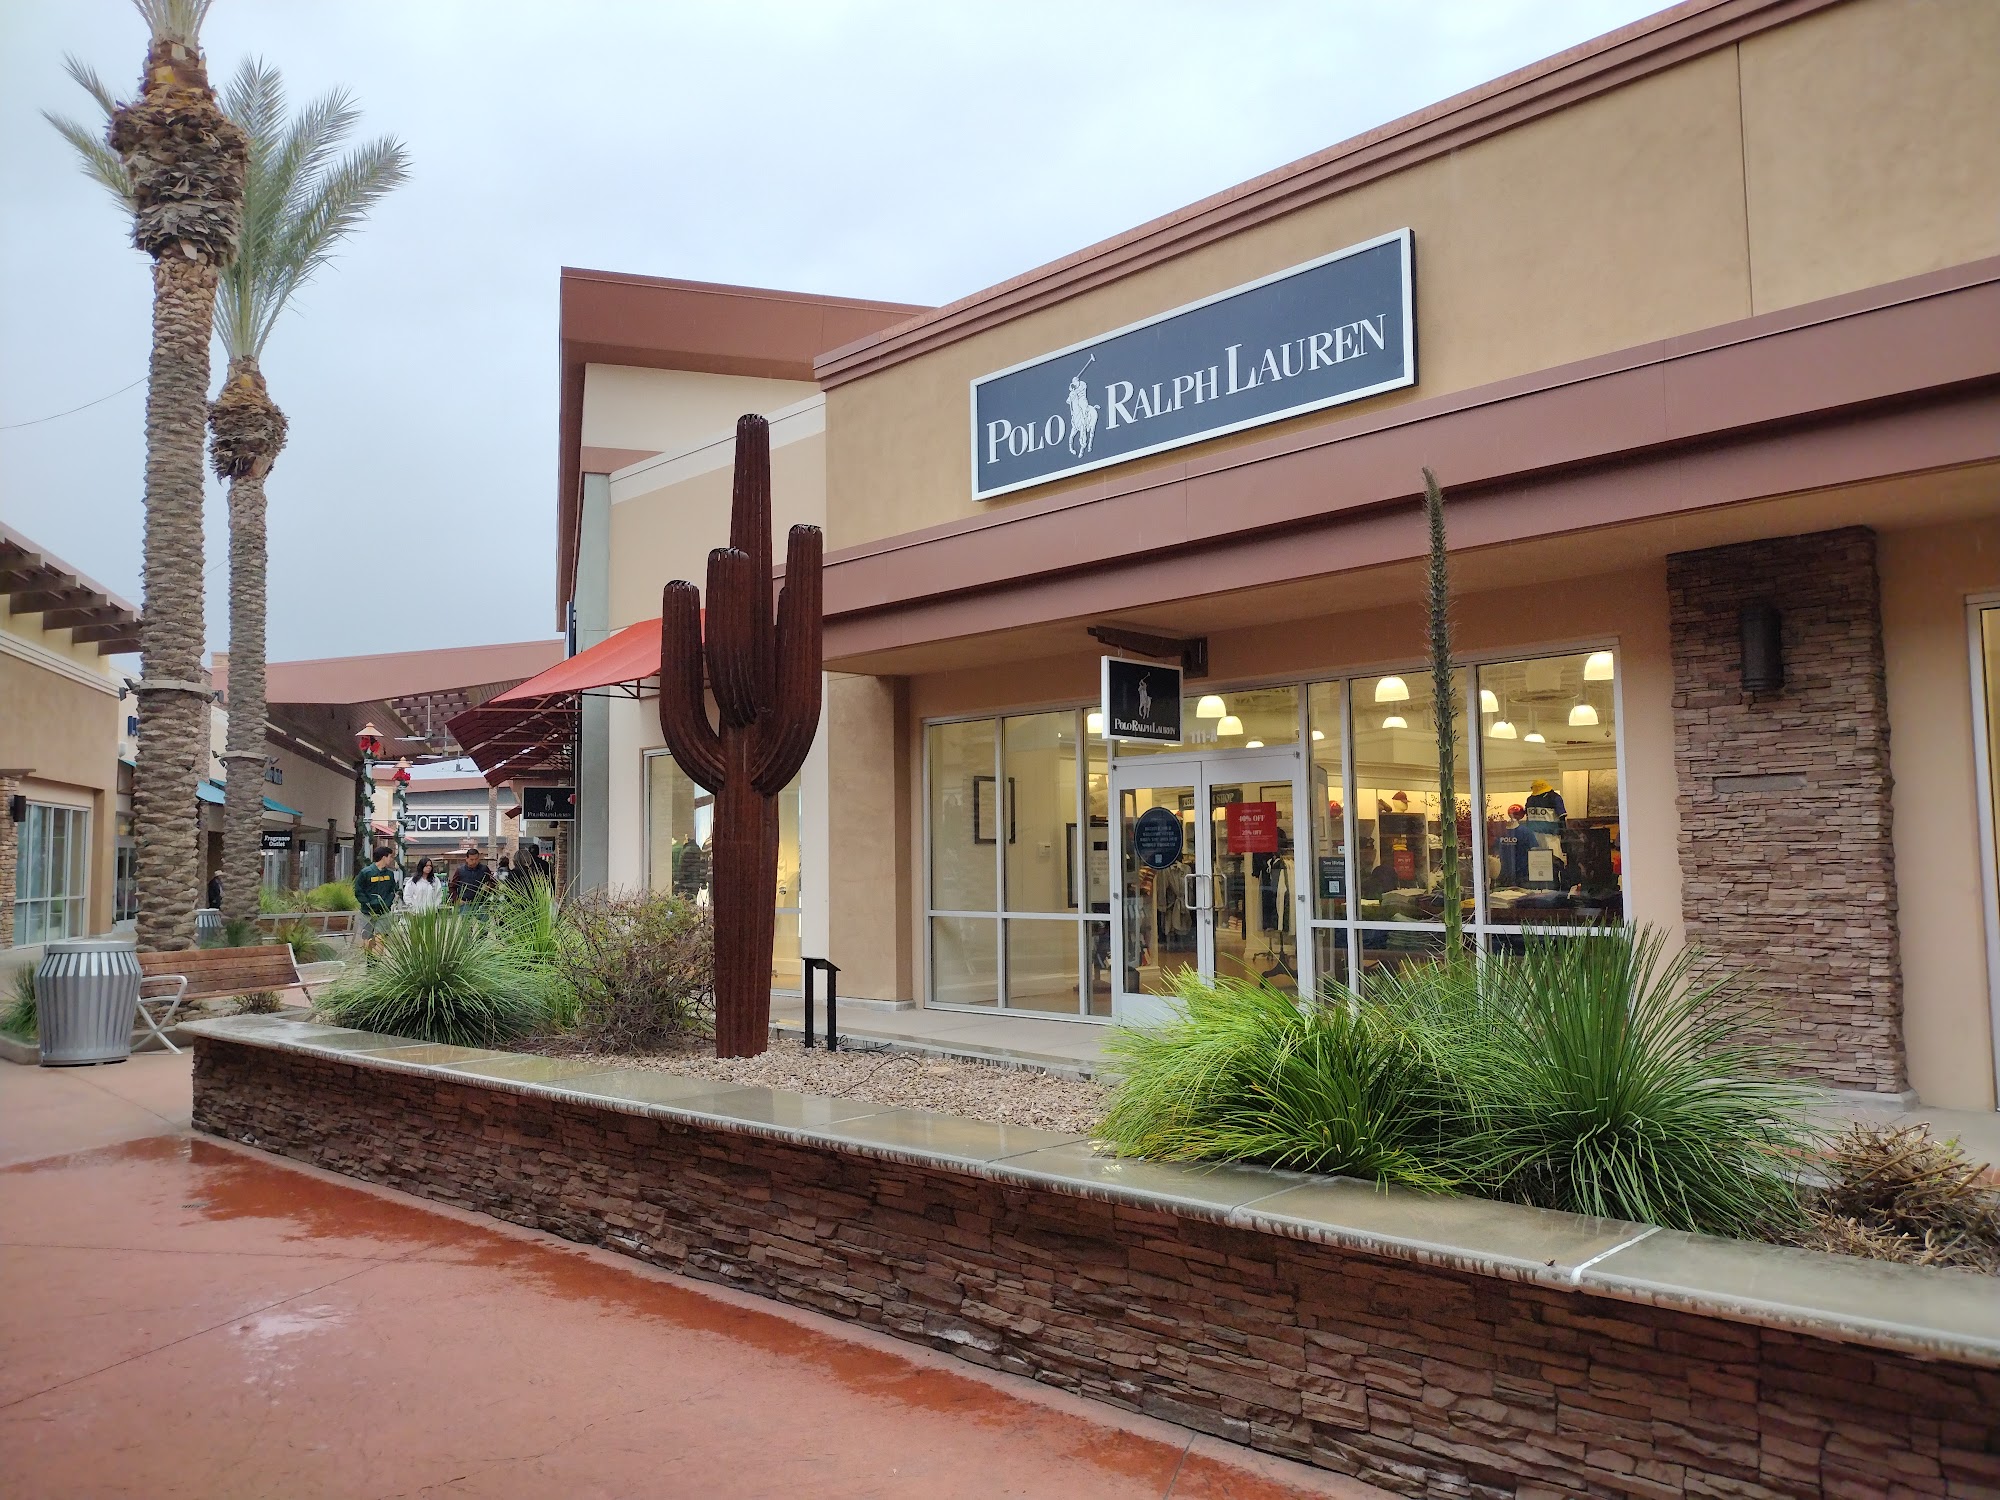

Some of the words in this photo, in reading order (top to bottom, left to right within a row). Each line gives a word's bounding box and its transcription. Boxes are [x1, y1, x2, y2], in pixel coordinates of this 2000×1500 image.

[986, 414, 1066, 465] POLO
[1105, 365, 1219, 430] RALPH
[1225, 313, 1388, 396] LAUREN
[1114, 718, 1132, 731] POLO
[1132, 720, 1152, 732] RALPH
[1152, 722, 1176, 735] LAUREN
[418, 815, 448, 831] OFF
[448, 815, 478, 830] 5TH
[1252, 814, 1266, 822] OFF
[264, 834, 291, 844] Fragrance
